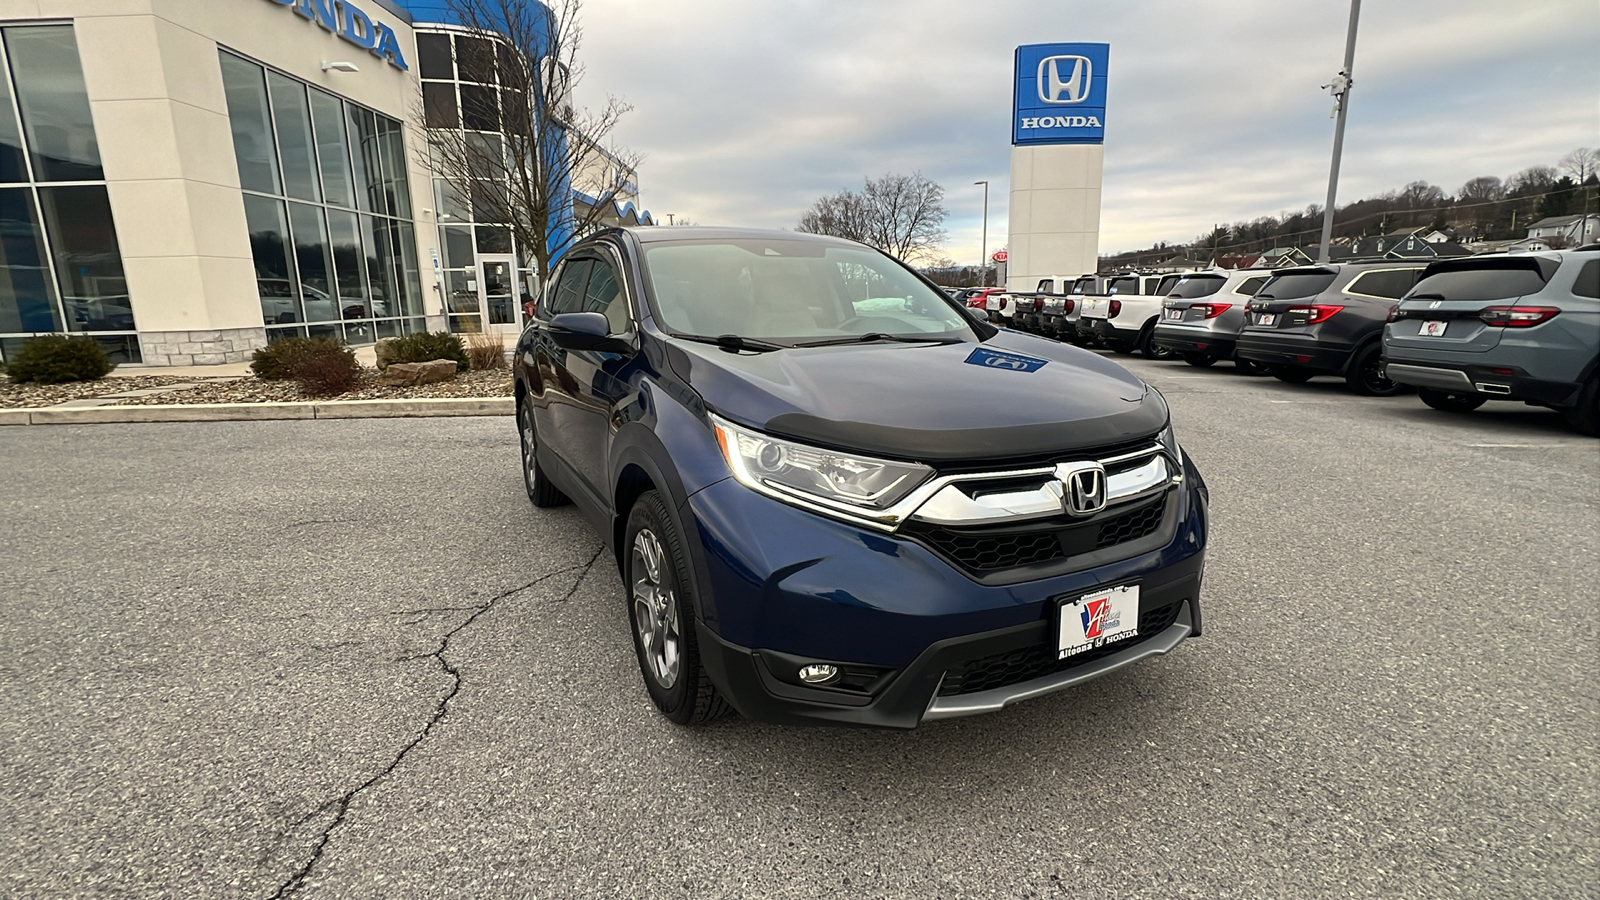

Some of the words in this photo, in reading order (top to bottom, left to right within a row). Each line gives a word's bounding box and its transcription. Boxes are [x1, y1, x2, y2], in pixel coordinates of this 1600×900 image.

[270, 0, 409, 71] NDA
[1021, 116, 1102, 129] HONDA
[1058, 642, 1093, 660] Altoona
[1105, 629, 1138, 644] HONDA
